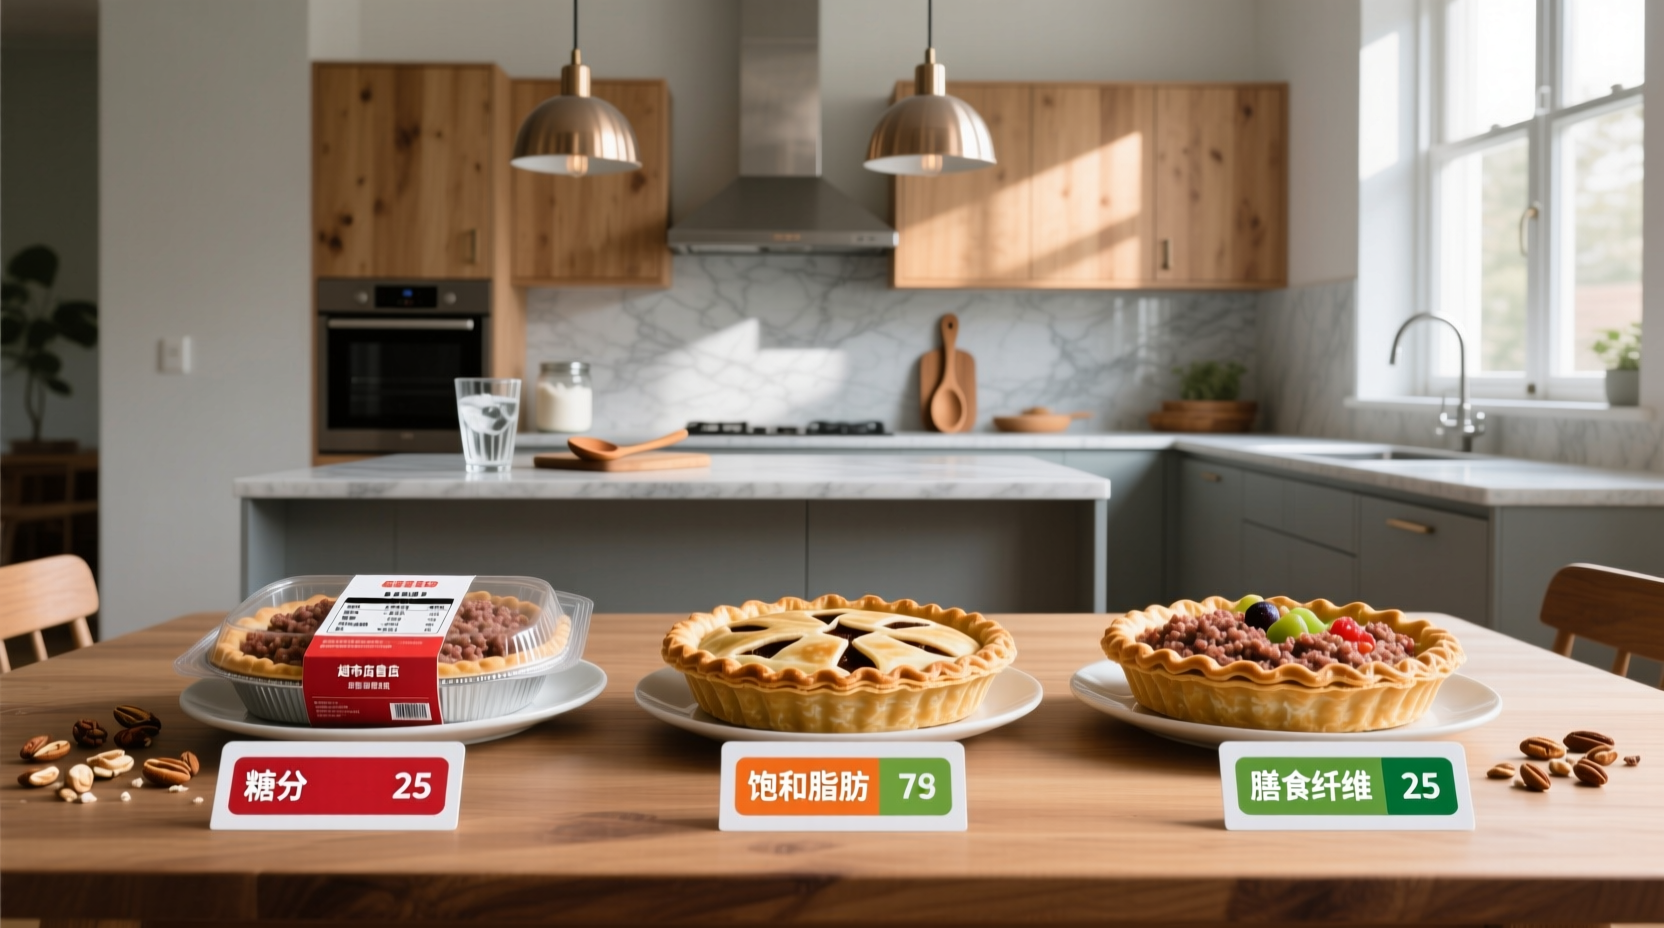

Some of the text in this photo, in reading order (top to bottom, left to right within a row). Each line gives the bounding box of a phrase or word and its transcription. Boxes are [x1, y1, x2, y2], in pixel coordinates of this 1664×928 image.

[243, 769, 432, 802] 糖分 25
[748, 770, 936, 802] 饱和脂肪 79
[1250, 769, 1440, 801] 膳食纤维 25
